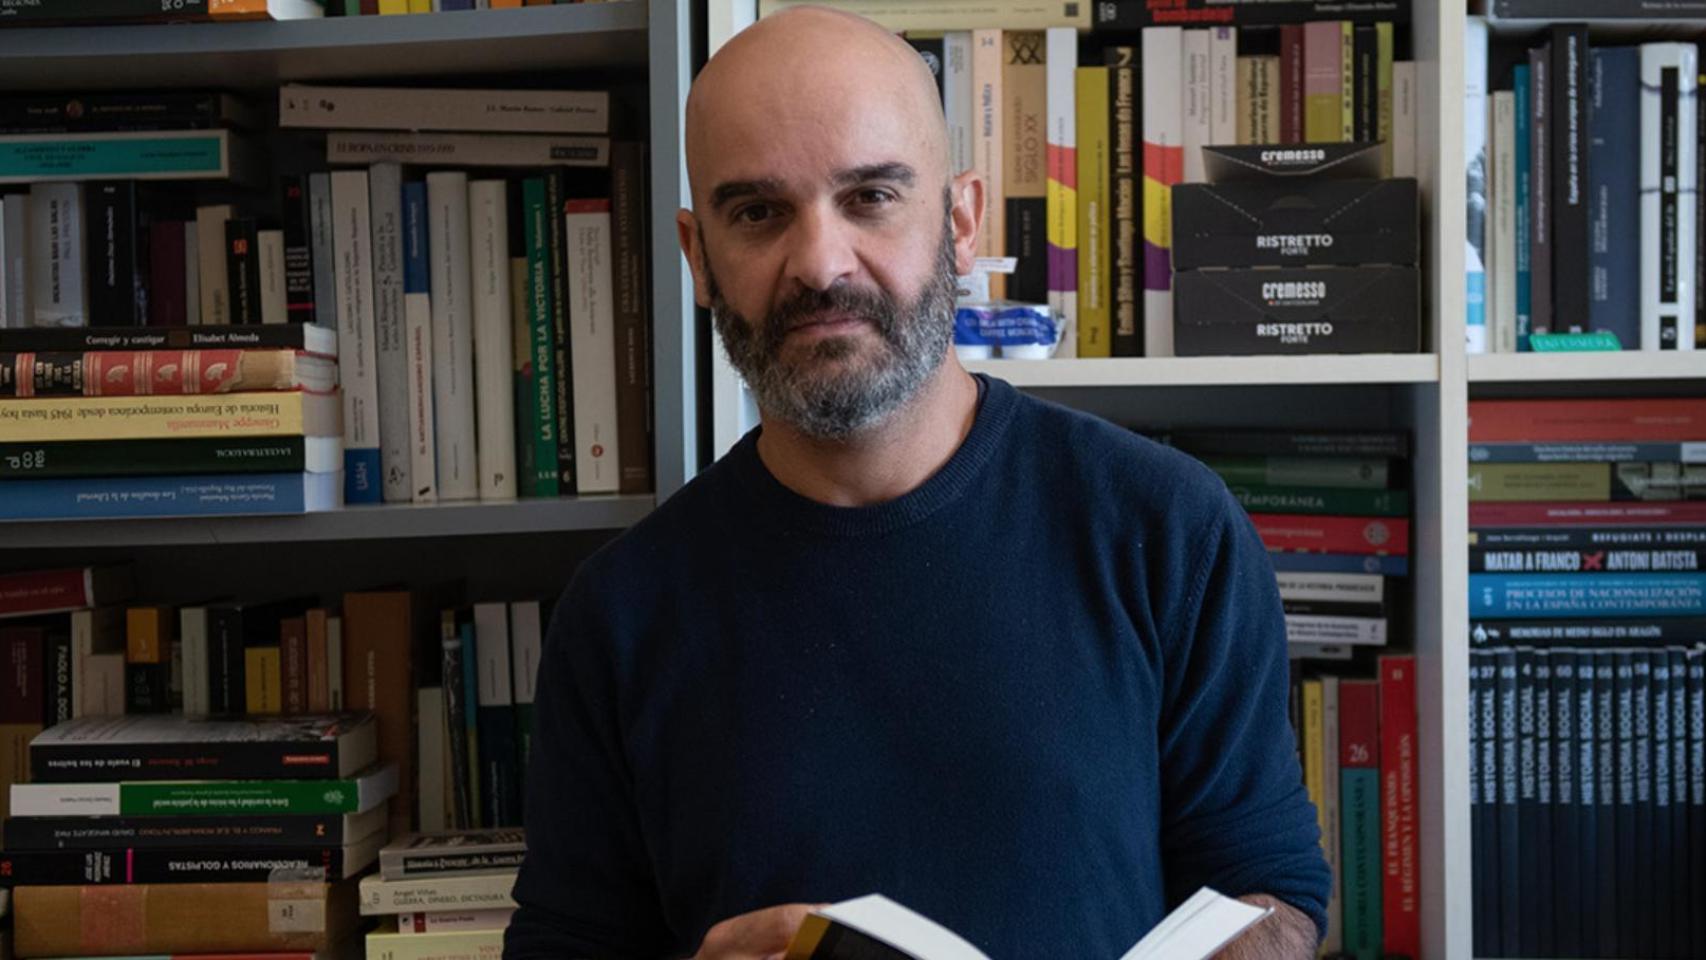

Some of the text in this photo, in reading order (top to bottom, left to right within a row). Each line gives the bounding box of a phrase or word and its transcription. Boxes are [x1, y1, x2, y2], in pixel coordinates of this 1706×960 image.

[1261, 150, 1326, 162] cremesso
[1257, 233, 1333, 248] RISTRETTO
[1262, 282, 1326, 299] cremesso
[1257, 322, 1333, 336] RISTRETTO
[86, 335, 122, 346] Corregir
[131, 334, 164, 346] castigar
[193, 332, 225, 343] Elisabet
[227, 332, 259, 342] Almeda
[533, 261, 552, 440] LA LUCHA POR LA VICTORIA
[22, 409, 48, 420] hasta
[50, 409, 73, 420] 1945
[76, 408, 106, 419] desde
[187, 403, 222, 415] Europa
[224, 405, 237, 415] de
[239, 404, 279, 415] Historia
[1591, 532, 1653, 544] REFUGIATS
[1484, 550, 1698, 571] MATAR A FRANCO ANTONI BATISTA
[1505, 586, 1702, 599] PROCESOS DE NACIONALIZACIÓN
[1505, 600, 1522, 611] EN
[1525, 600, 1542, 611] LA
[1544, 598, 1587, 611] ESPAÑA
[1481, 690, 1496, 803] HISTORIA SOCIAL
[1502, 690, 1517, 804] HISTORIA SOCIAL
[1520, 686, 1534, 798] HISTORIA SOCIAL
[1537, 689, 1550, 803] HISTORIA SOCIAL
[1557, 689, 1571, 803] HISTORIA SOCIAL
[1579, 690, 1594, 804] HISTORIA SOCIAL
[1599, 690, 1613, 804] HISTORIA SOCIAL
[1619, 689, 1633, 804] HISTORIA SOCIAL
[1636, 686, 1649, 800] HISTORIA SOCIAL
[1655, 690, 1668, 806] HISTORIA SOCIAL
[1673, 687, 1686, 802] HISTORIA SOCIAL
[1691, 690, 1704, 804] HISTORIA SOCIAL
[1349, 743, 1369, 762] 26
[1386, 770, 1398, 875] EL FRANQUISMO
[168, 860, 221, 872] GOLPISTAS
[231, 859, 309, 871] REACCIONARIOS
